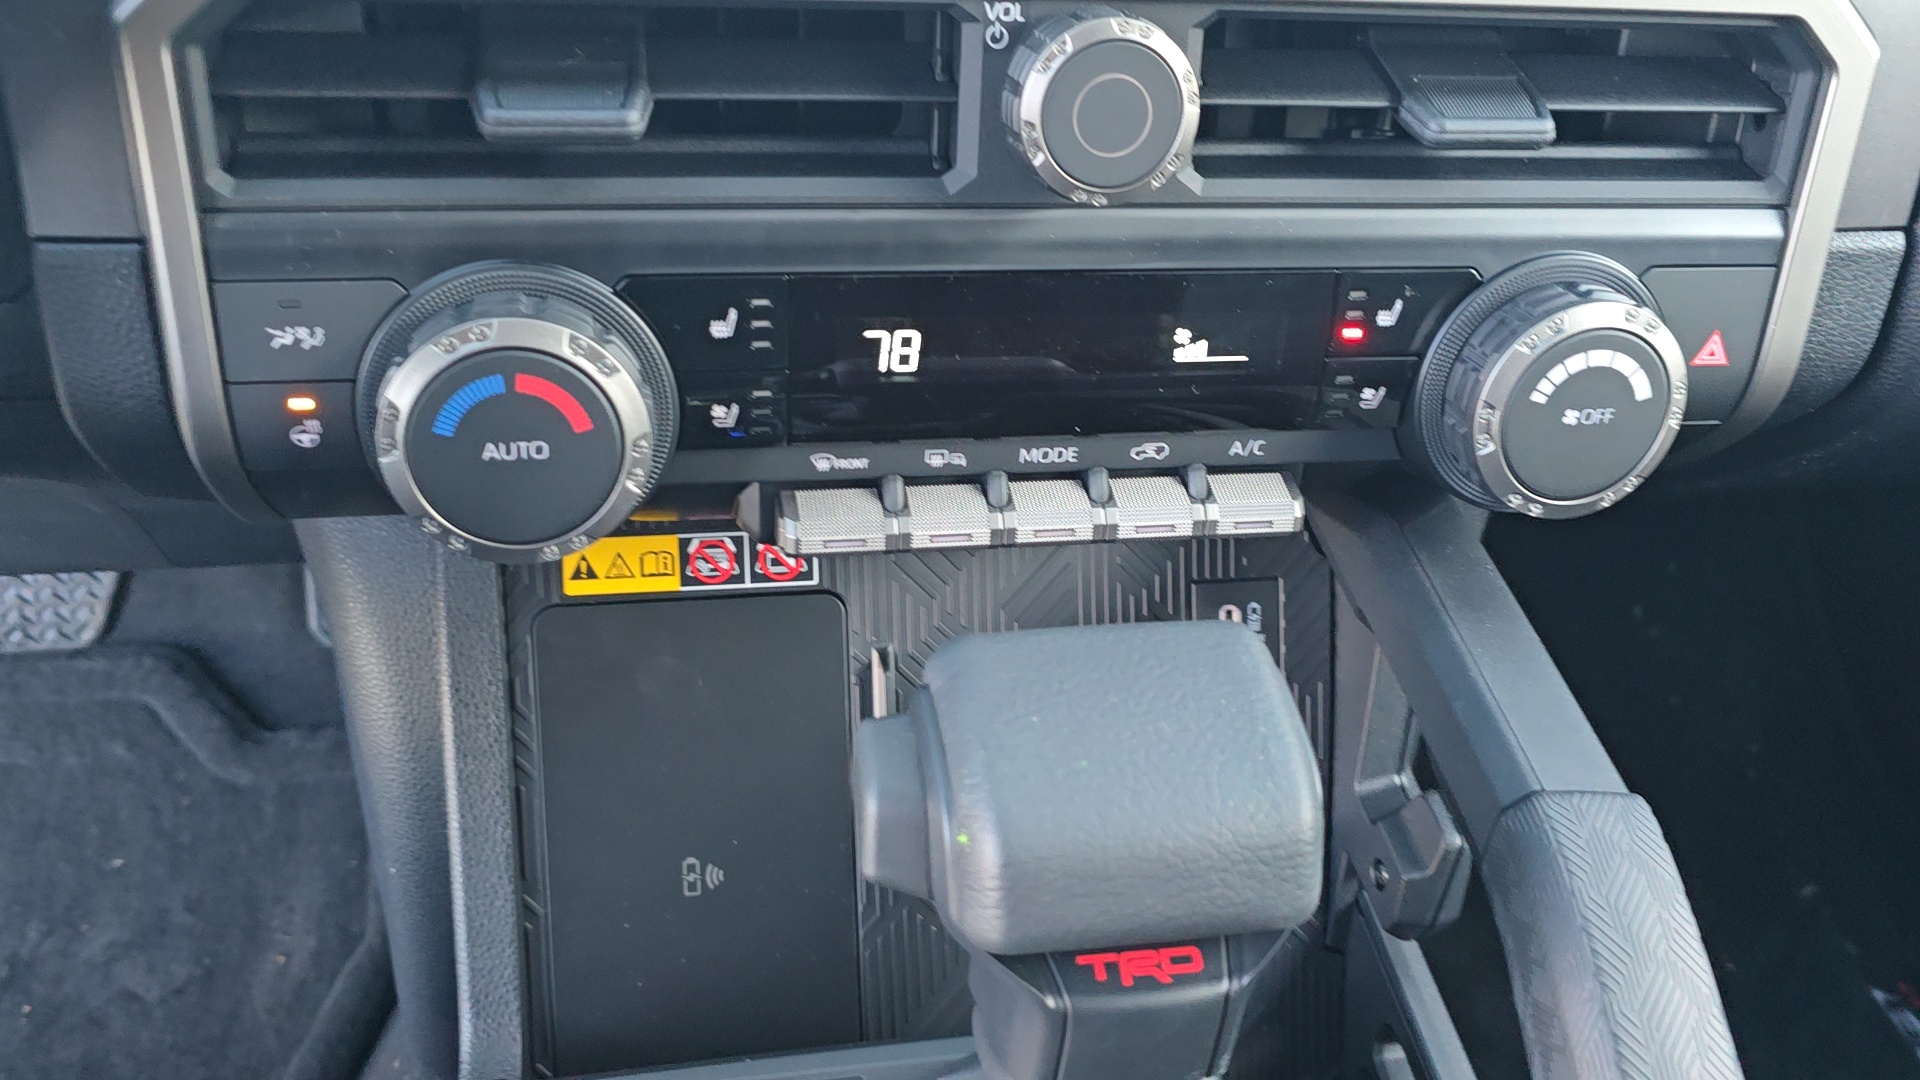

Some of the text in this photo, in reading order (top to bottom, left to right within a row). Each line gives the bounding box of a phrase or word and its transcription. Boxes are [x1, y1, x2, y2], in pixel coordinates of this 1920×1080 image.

[983, 1, 1026, 22] VOL
[862, 329, 922, 373] 78
[1580, 407, 1617, 425] OFF
[481, 440, 550, 461] AUTO
[1019, 446, 1080, 464] MODE
[1228, 439, 1267, 457] A/C
[1074, 945, 1205, 987] TRD
